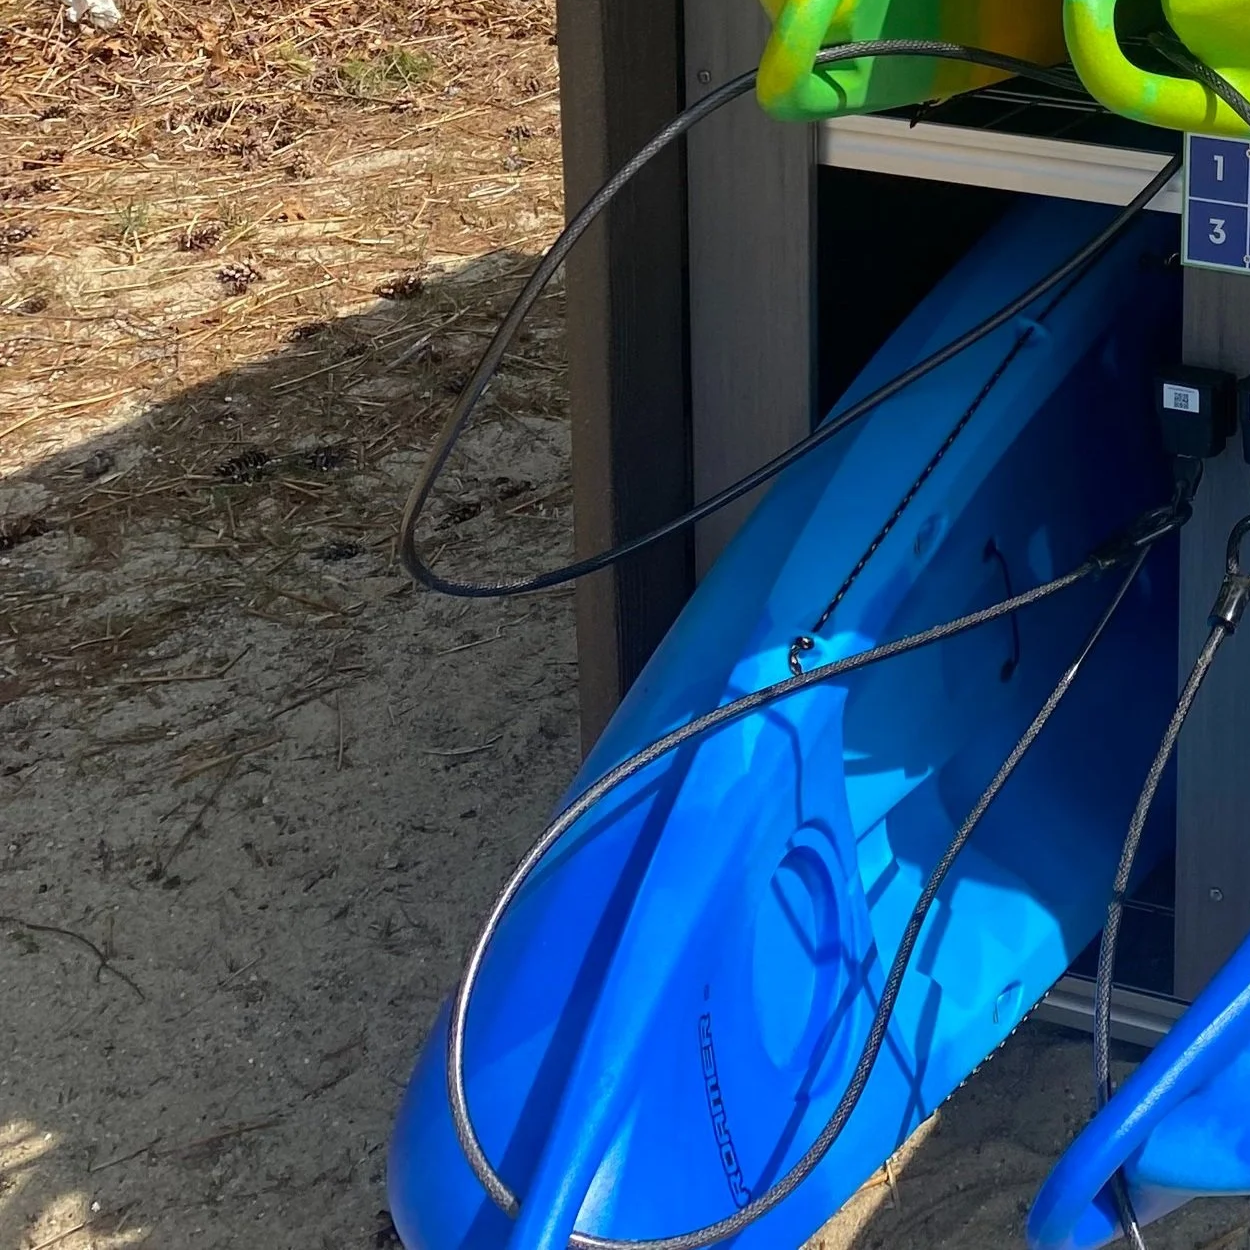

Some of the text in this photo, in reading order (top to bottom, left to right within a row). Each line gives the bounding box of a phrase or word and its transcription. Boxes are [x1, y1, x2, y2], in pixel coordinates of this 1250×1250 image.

[1213, 155, 1224, 181] 1
[1208, 218, 1226, 244] 3
[698, 1012, 752, 1209] ROAMER
